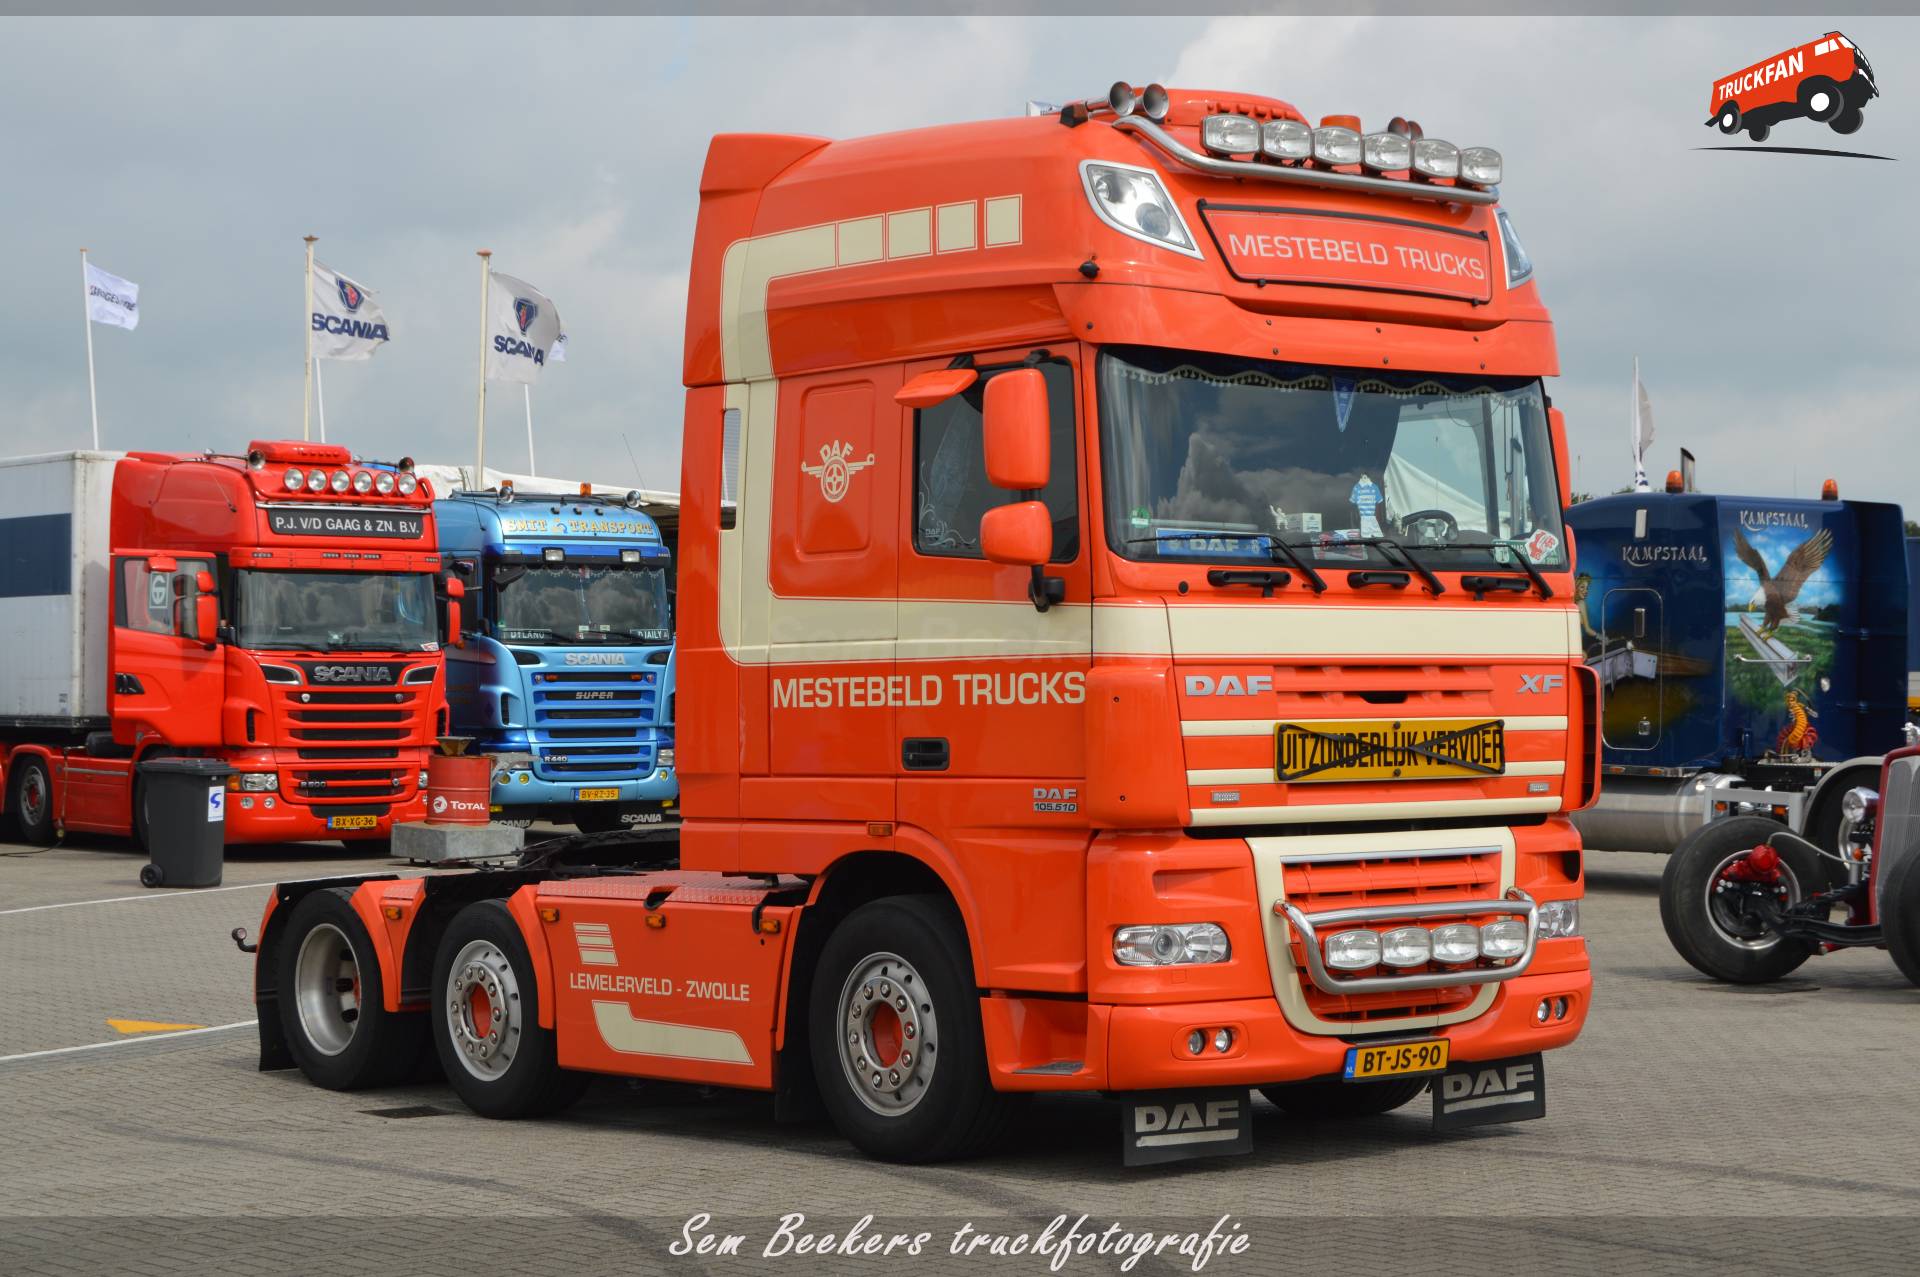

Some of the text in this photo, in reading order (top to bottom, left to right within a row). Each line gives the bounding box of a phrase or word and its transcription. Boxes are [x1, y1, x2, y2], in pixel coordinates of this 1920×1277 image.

[1228, 234, 1485, 280] MESTEBELD TRUCKS
[312, 312, 390, 341] SCANIA
[819, 439, 854, 463] DAF
[275, 516, 420, 533] P.J. V/D GAAG & ZN. B.V.
[506, 519, 654, 535] SMIT TRANSPORT
[1740, 510, 1809, 532] KAMPSTAAL
[1189, 538, 1240, 552] DAF
[1622, 545, 1708, 567] KAMPSTAAL
[565, 653, 627, 665] SCANIA
[313, 665, 392, 682] SCANIA
[1516, 674, 1564, 693] XF
[575, 691, 614, 700] SUPER
[772, 671, 1086, 708] MESTEBELD TRUCKS
[1185, 675, 1273, 696] DAF
[1281, 728, 1503, 770] UITZONDERLIJK VERVOER
[1033, 788, 1077, 800] DAF
[450, 800, 486, 810] TOTAL
[1034, 802, 1077, 812] 105.510
[336, 816, 374, 826] BX-XG-36
[621, 813, 662, 823] SCANIA
[569, 972, 672, 996] LEMELERVELD
[686, 980, 750, 1001] ZWOLLE
[1363, 1045, 1441, 1072] BT-JS-90
[1443, 1064, 1534, 1099] DAF
[1135, 1100, 1239, 1132] DAF
